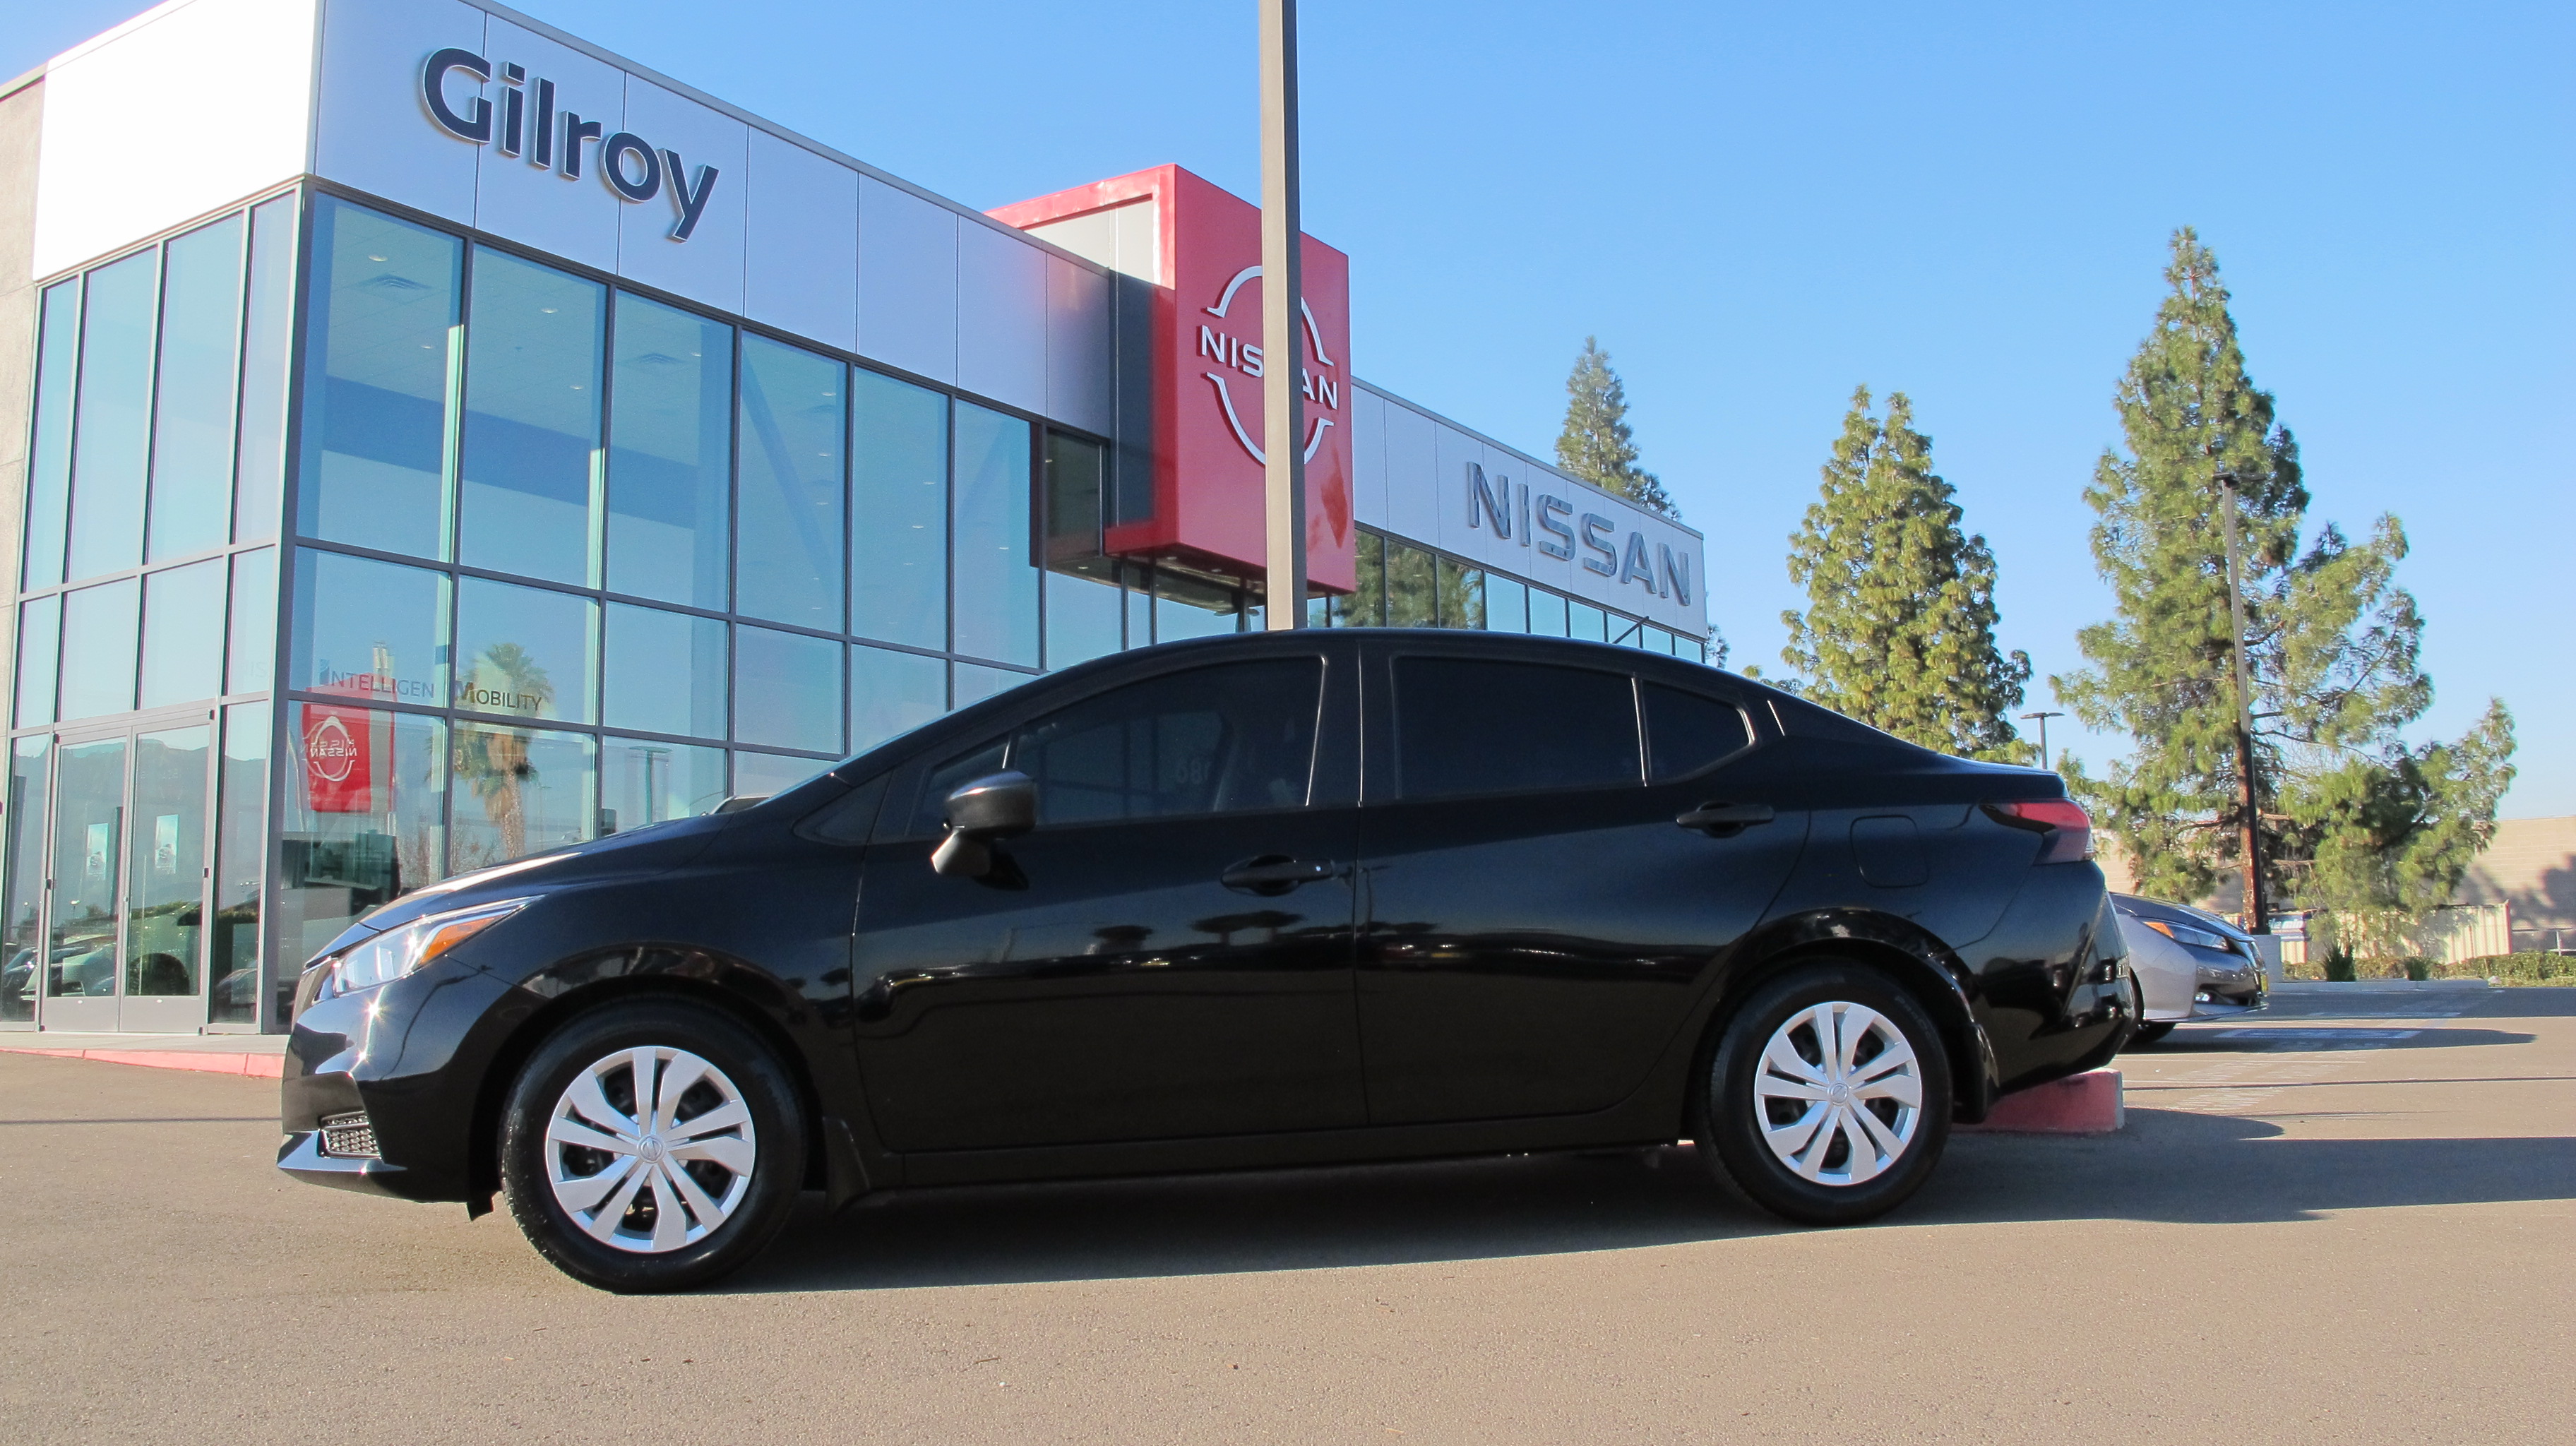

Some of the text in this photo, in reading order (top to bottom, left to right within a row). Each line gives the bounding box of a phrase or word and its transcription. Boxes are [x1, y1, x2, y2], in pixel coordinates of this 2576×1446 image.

[419, 47, 720, 243] Gilroy
[1202, 324, 1337, 410] NISAN
[1467, 461, 1691, 606] NISSAN
[319, 664, 435, 698] INTELLIGEN
